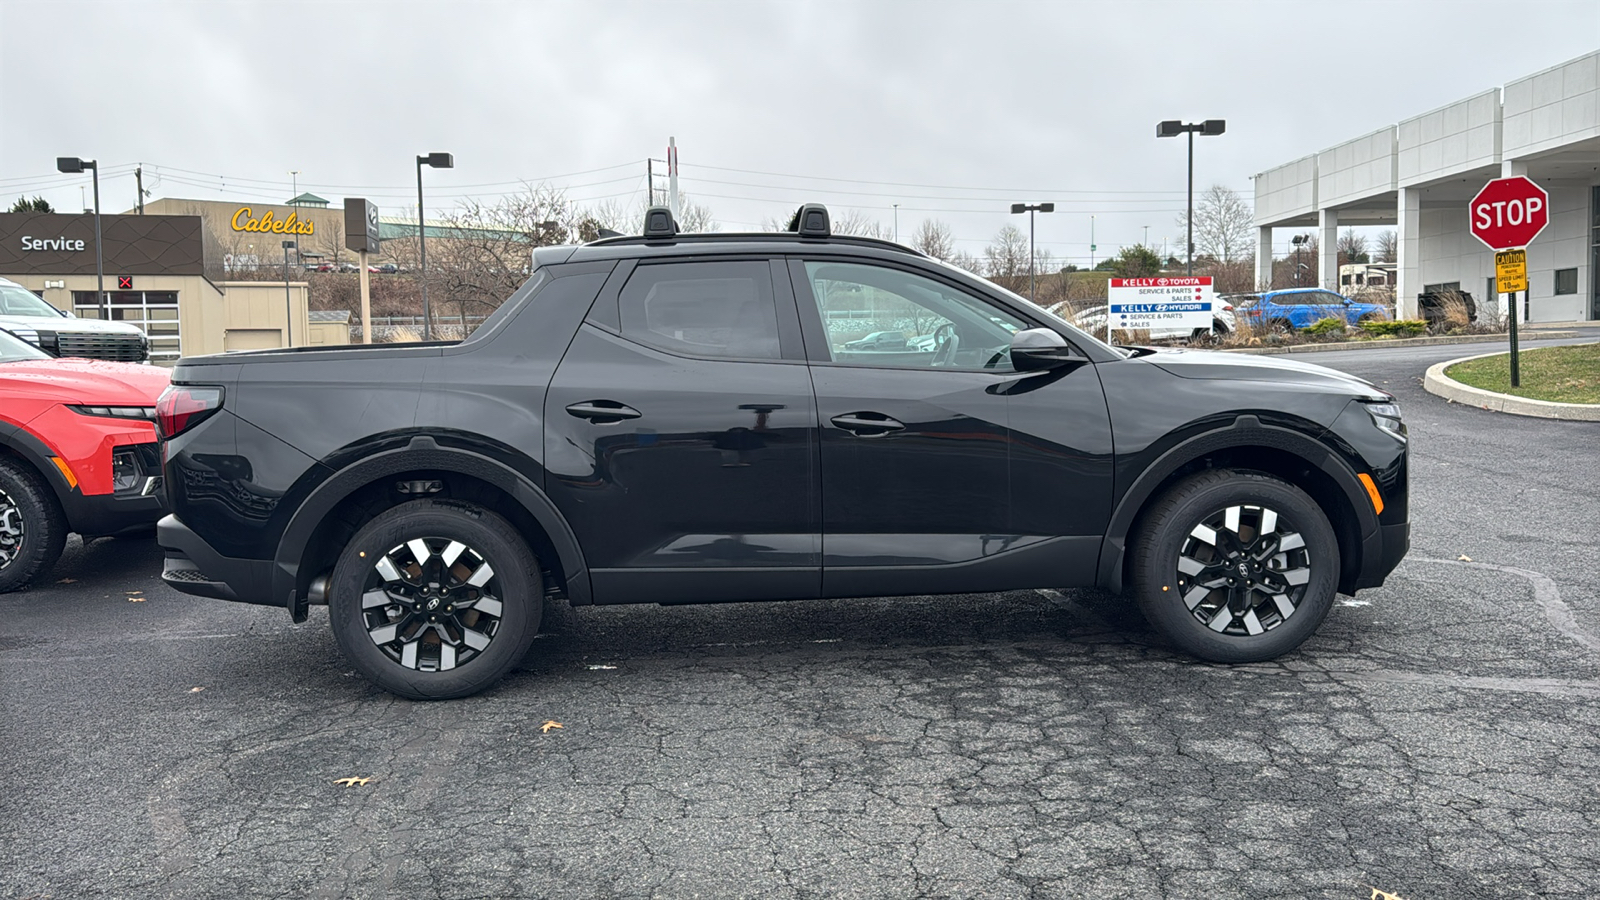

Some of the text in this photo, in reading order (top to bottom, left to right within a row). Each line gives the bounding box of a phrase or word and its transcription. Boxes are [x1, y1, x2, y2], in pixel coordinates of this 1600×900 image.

[231, 206, 314, 235] Cabela's
[1476, 197, 1543, 230] STOP
[21, 235, 85, 251] Service
[1497, 252, 1525, 264] CAUTION
[1122, 278, 1154, 286] KELLY
[1121, 304, 1153, 312] KELLY
